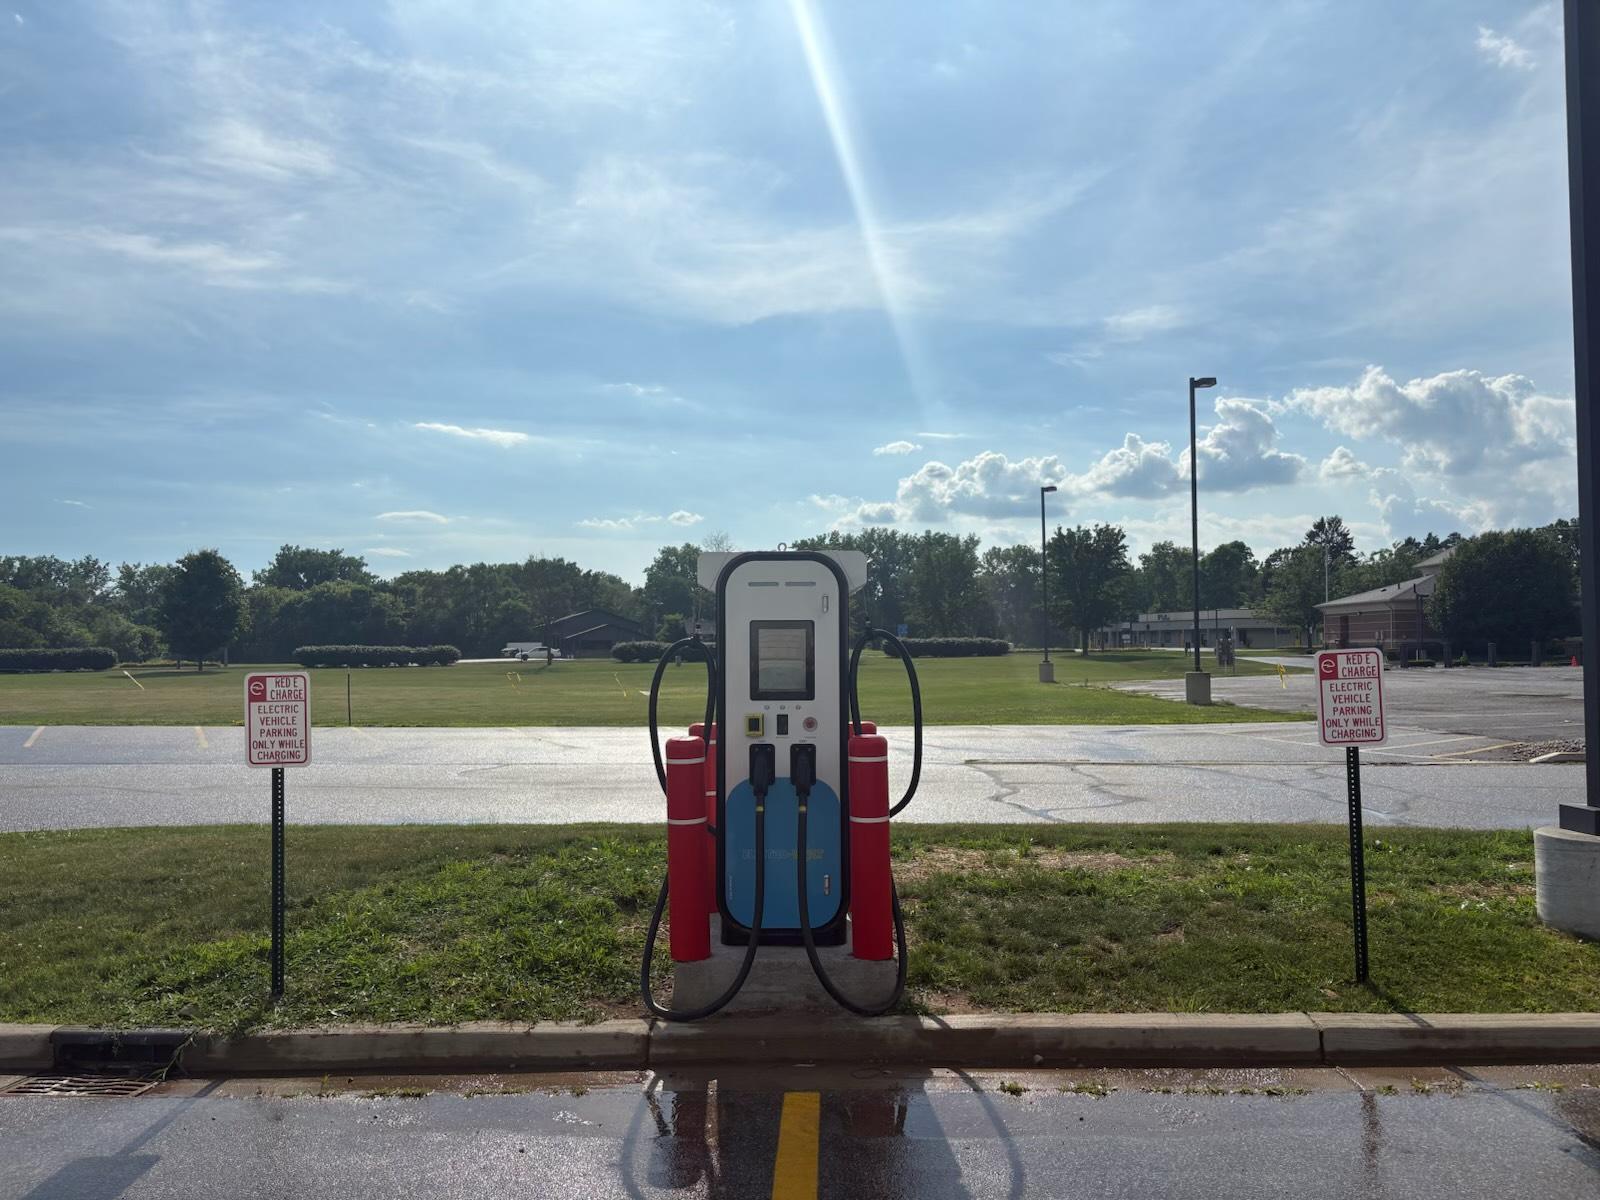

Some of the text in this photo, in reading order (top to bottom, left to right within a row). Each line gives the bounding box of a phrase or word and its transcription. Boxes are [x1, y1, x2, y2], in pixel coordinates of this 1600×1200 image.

[1346, 654, 1370, 665] RED E
[1342, 666, 1376, 677] CHARGE
[275, 677, 298, 688] RED E
[1329, 682, 1373, 692] ELECTRIC
[270, 689, 303, 700] CHARGE
[1332, 694, 1371, 704] VEHICLE
[257, 705, 299, 714] ELECTRIC
[1332, 706, 1372, 716] PARKING
[259, 716, 297, 726] VEHICLE
[1326, 717, 1380, 728] ONLY WHILE
[260, 728, 298, 737] PARKING
[1331, 729, 1377, 739] CHARGING
[252, 739, 304, 750] ONLY WHILE
[257, 751, 301, 760] CHARGING
